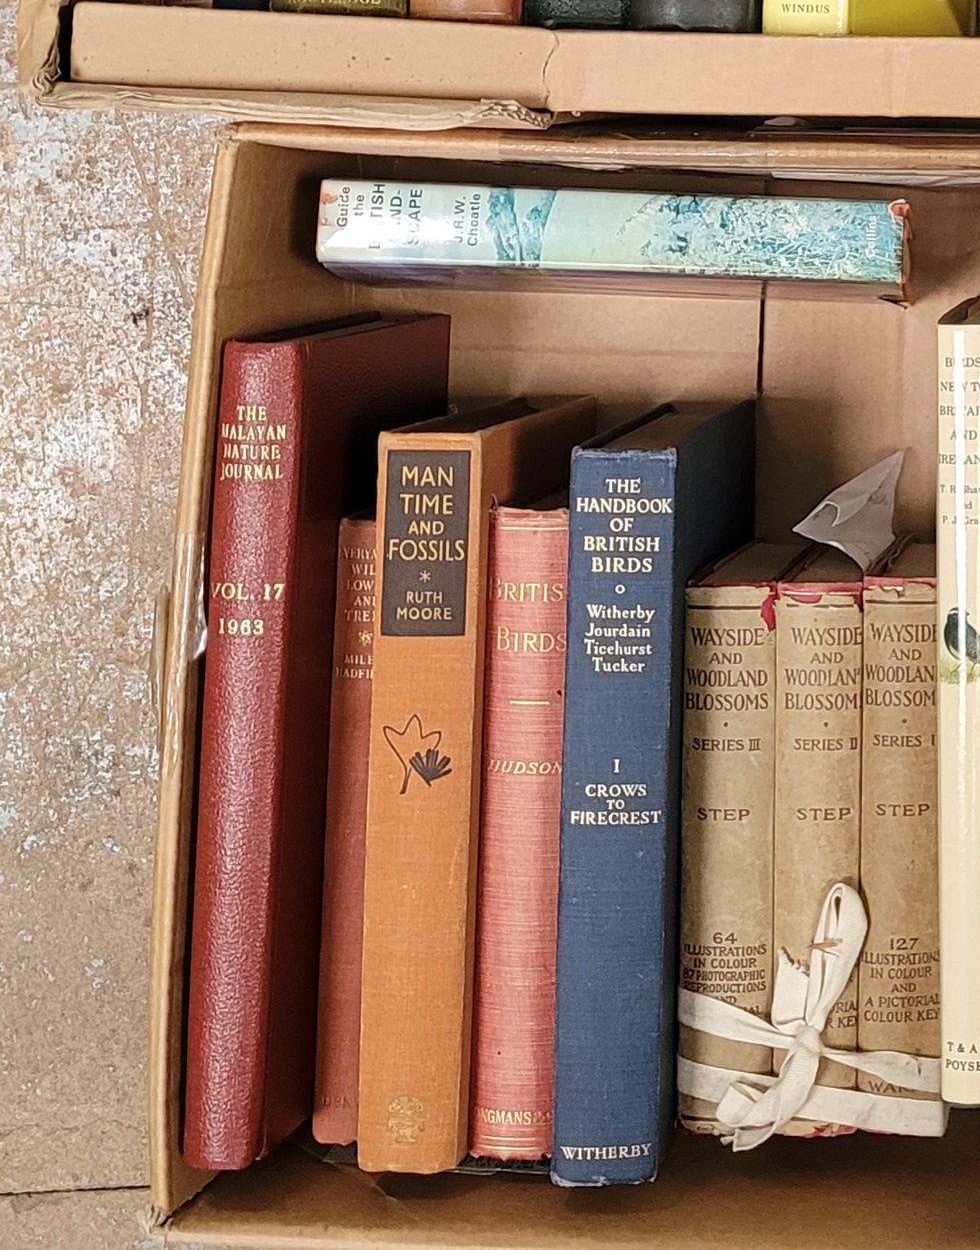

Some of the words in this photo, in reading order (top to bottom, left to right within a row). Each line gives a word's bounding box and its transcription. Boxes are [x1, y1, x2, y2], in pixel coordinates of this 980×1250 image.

[781, 4, 830, 14] WINDUS
[237, 405, 267, 421] THE
[223, 444, 281, 460] NATURE
[220, 464, 284, 480] JOURNAL
[401, 466, 454, 487] MAN
[606, 478, 641, 493] THE
[400, 494, 453, 516] TIME
[576, 498, 672, 513] HANDBOOK
[408, 521, 445, 536] AND
[610, 517, 633, 532] OF
[388, 539, 465, 562] FOSSILS
[584, 536, 660, 552] BRITISH
[591, 557, 652, 573] BIRDS
[406, 591, 443, 604] RUTH
[397, 607, 452, 620] MOORE
[586, 604, 655, 623] Witherby
[218, 619, 264, 635] 1963
[585, 623, 651, 638] Jourdain
[691, 627, 765, 646] WAYSIDE
[584, 638, 652, 655] Ticehurst
[592, 656, 645, 673] Tucker
[709, 652, 742, 665] AND
[687, 668, 768, 687] WOODLAND
[686, 693, 769, 711] BLOSSOMS
[692, 738, 744, 751] SERIES
[488, 759, 562, 775] HUDSON
[585, 784, 647, 797] CROWS
[606, 800, 625, 809] TO
[875, 803, 930, 817] STEP
[570, 810, 662, 825] FIRECREST
[697, 809, 750, 821] STEP
[796, 808, 851, 821] STEP
[712, 932, 737, 945] 64
[890, 938, 919, 950] 127
[710, 958, 757, 969] COLOUR
[870, 967, 883, 979] IN
[887, 967, 933, 978] COLOUR
[891, 983, 916, 993] AND
[560, 1143, 652, 1160] WITHERBY
